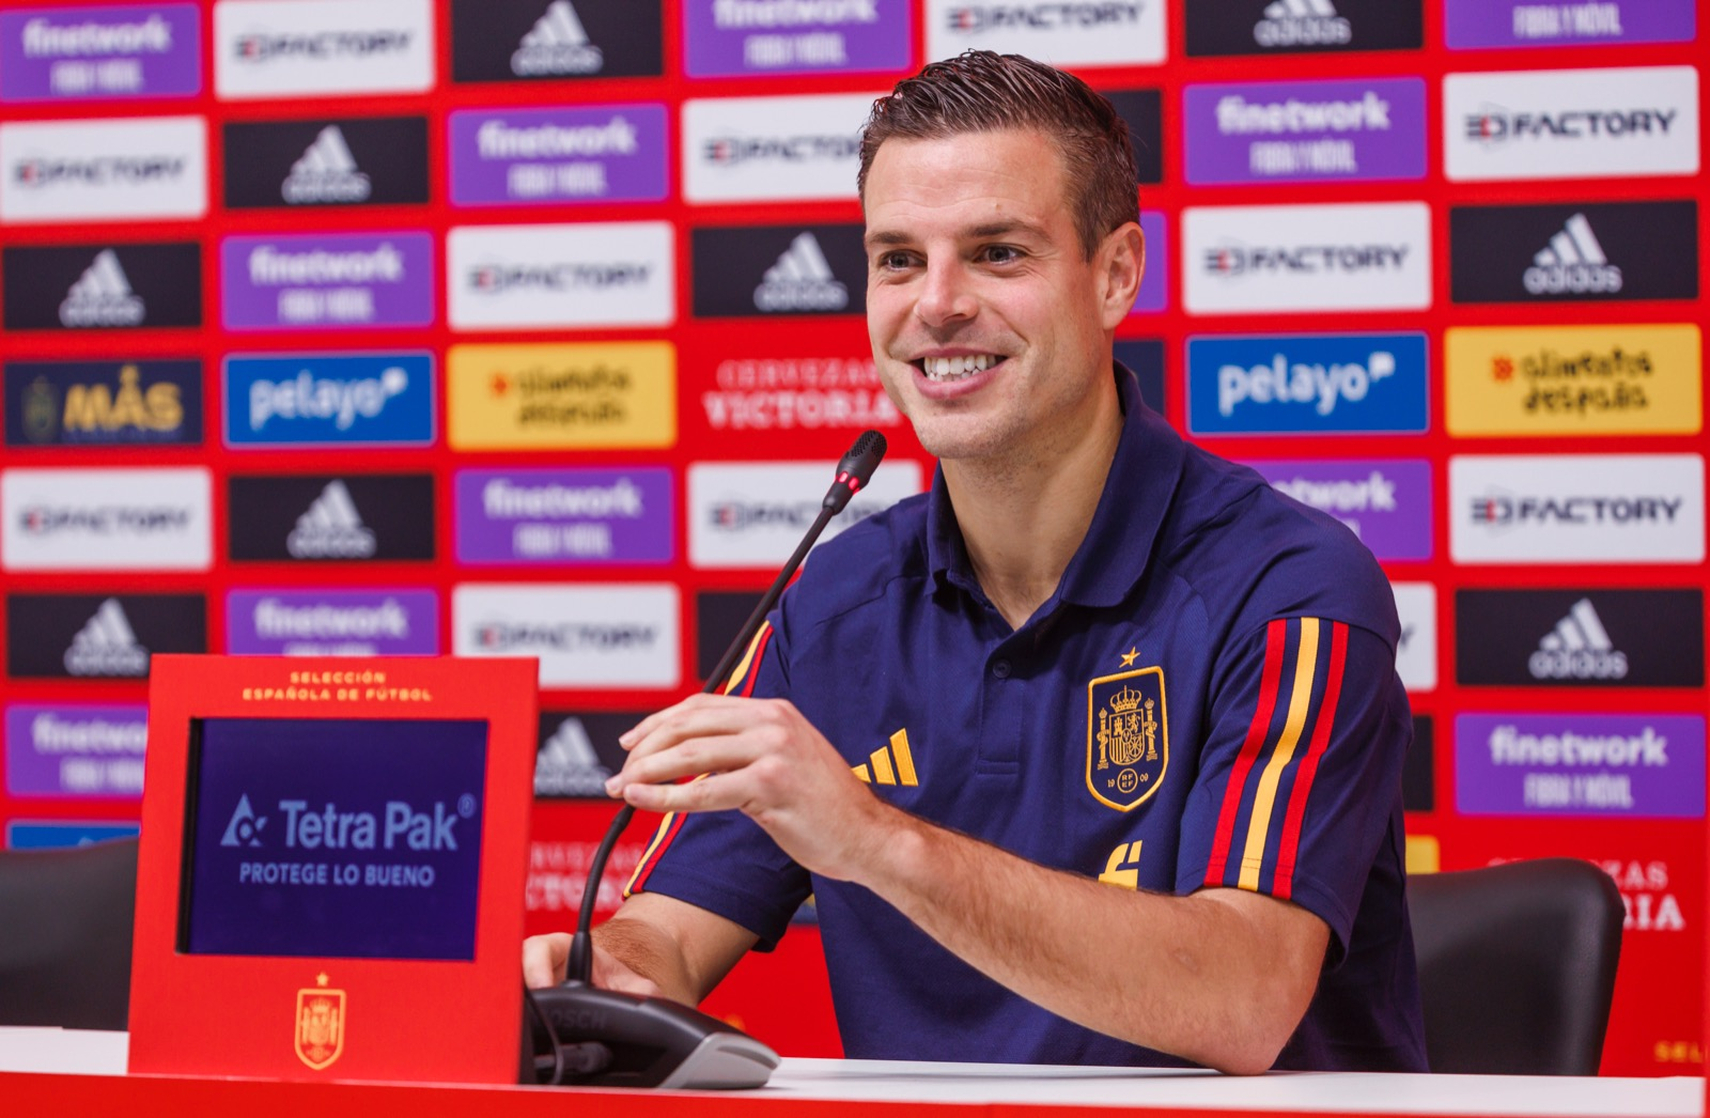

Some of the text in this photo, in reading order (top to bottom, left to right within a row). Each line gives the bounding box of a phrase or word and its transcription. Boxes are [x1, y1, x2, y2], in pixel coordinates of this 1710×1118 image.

[23, 15, 172, 57] finetwork
[1253, 17, 1352, 47] adidas
[511, 45, 603, 76] adidas
[1216, 91, 1390, 135] finetwork
[478, 116, 638, 159] finetwork
[282, 173, 371, 204] adidas
[249, 243, 404, 286] finetwork
[1523, 265, 1623, 294] adidas
[753, 279, 848, 311] adidas
[60, 297, 146, 328] adidas
[249, 368, 386, 430] pelayo
[1218, 353, 1370, 416] pelayo
[483, 478, 642, 519] finetwork
[287, 529, 376, 558] adidas
[254, 598, 408, 640] finetwork
[290, 668, 386, 684] SELECCIÓN
[1529, 651, 1628, 679] adidas
[243, 685, 433, 701] ESPAÑOLA DE FÚTBOL
[1489, 725, 1669, 766] finetwork
[279, 800, 376, 850] Tetra
[239, 861, 436, 888] PROTEGE LO BUENO
